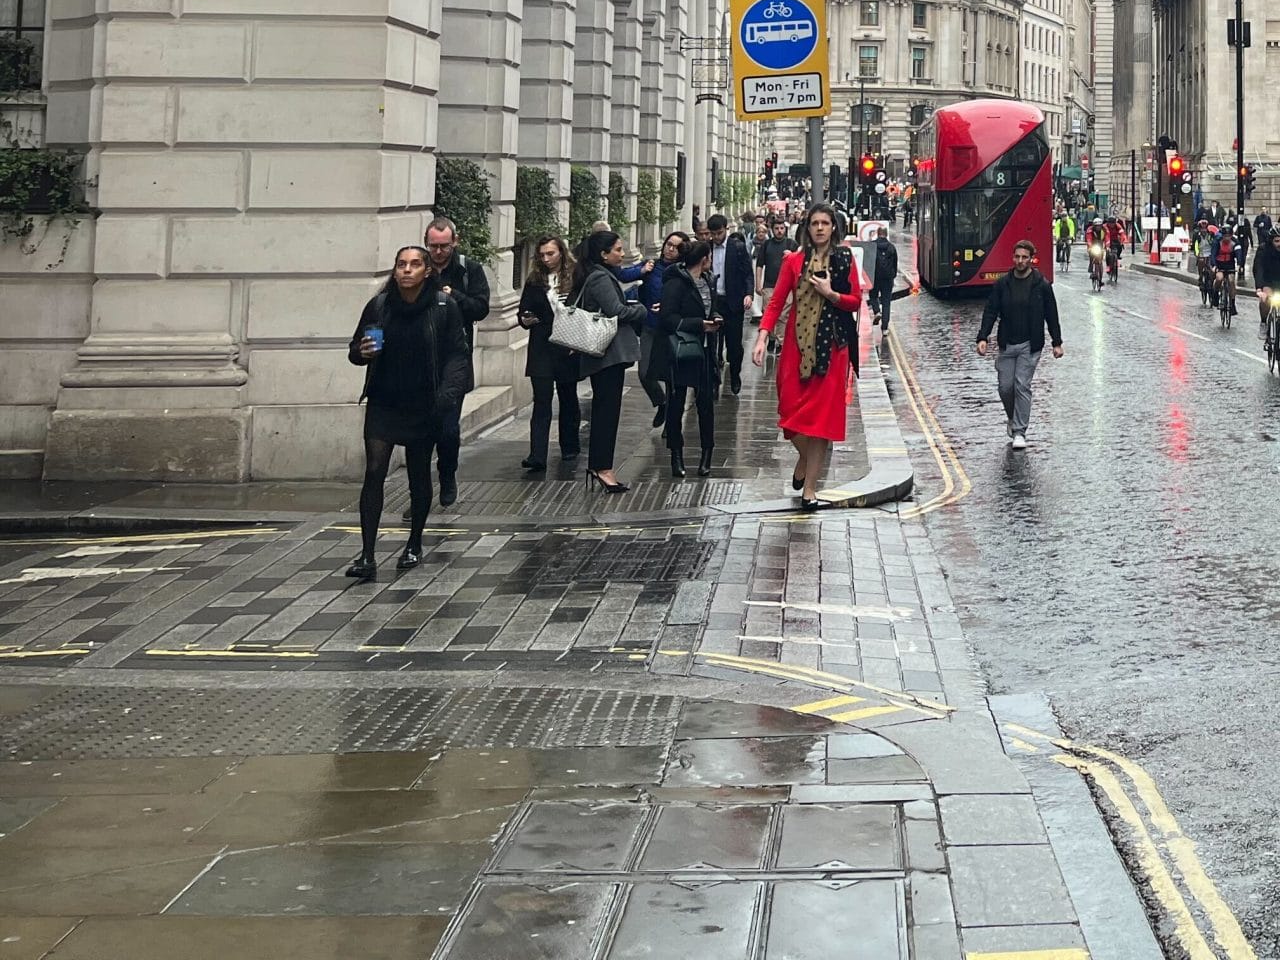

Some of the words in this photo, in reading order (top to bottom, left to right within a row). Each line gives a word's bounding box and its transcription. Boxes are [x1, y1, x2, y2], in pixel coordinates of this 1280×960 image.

[755, 82, 782, 92] Mon
[793, 79, 809, 90] Fri
[996, 172, 1006, 185] 8
